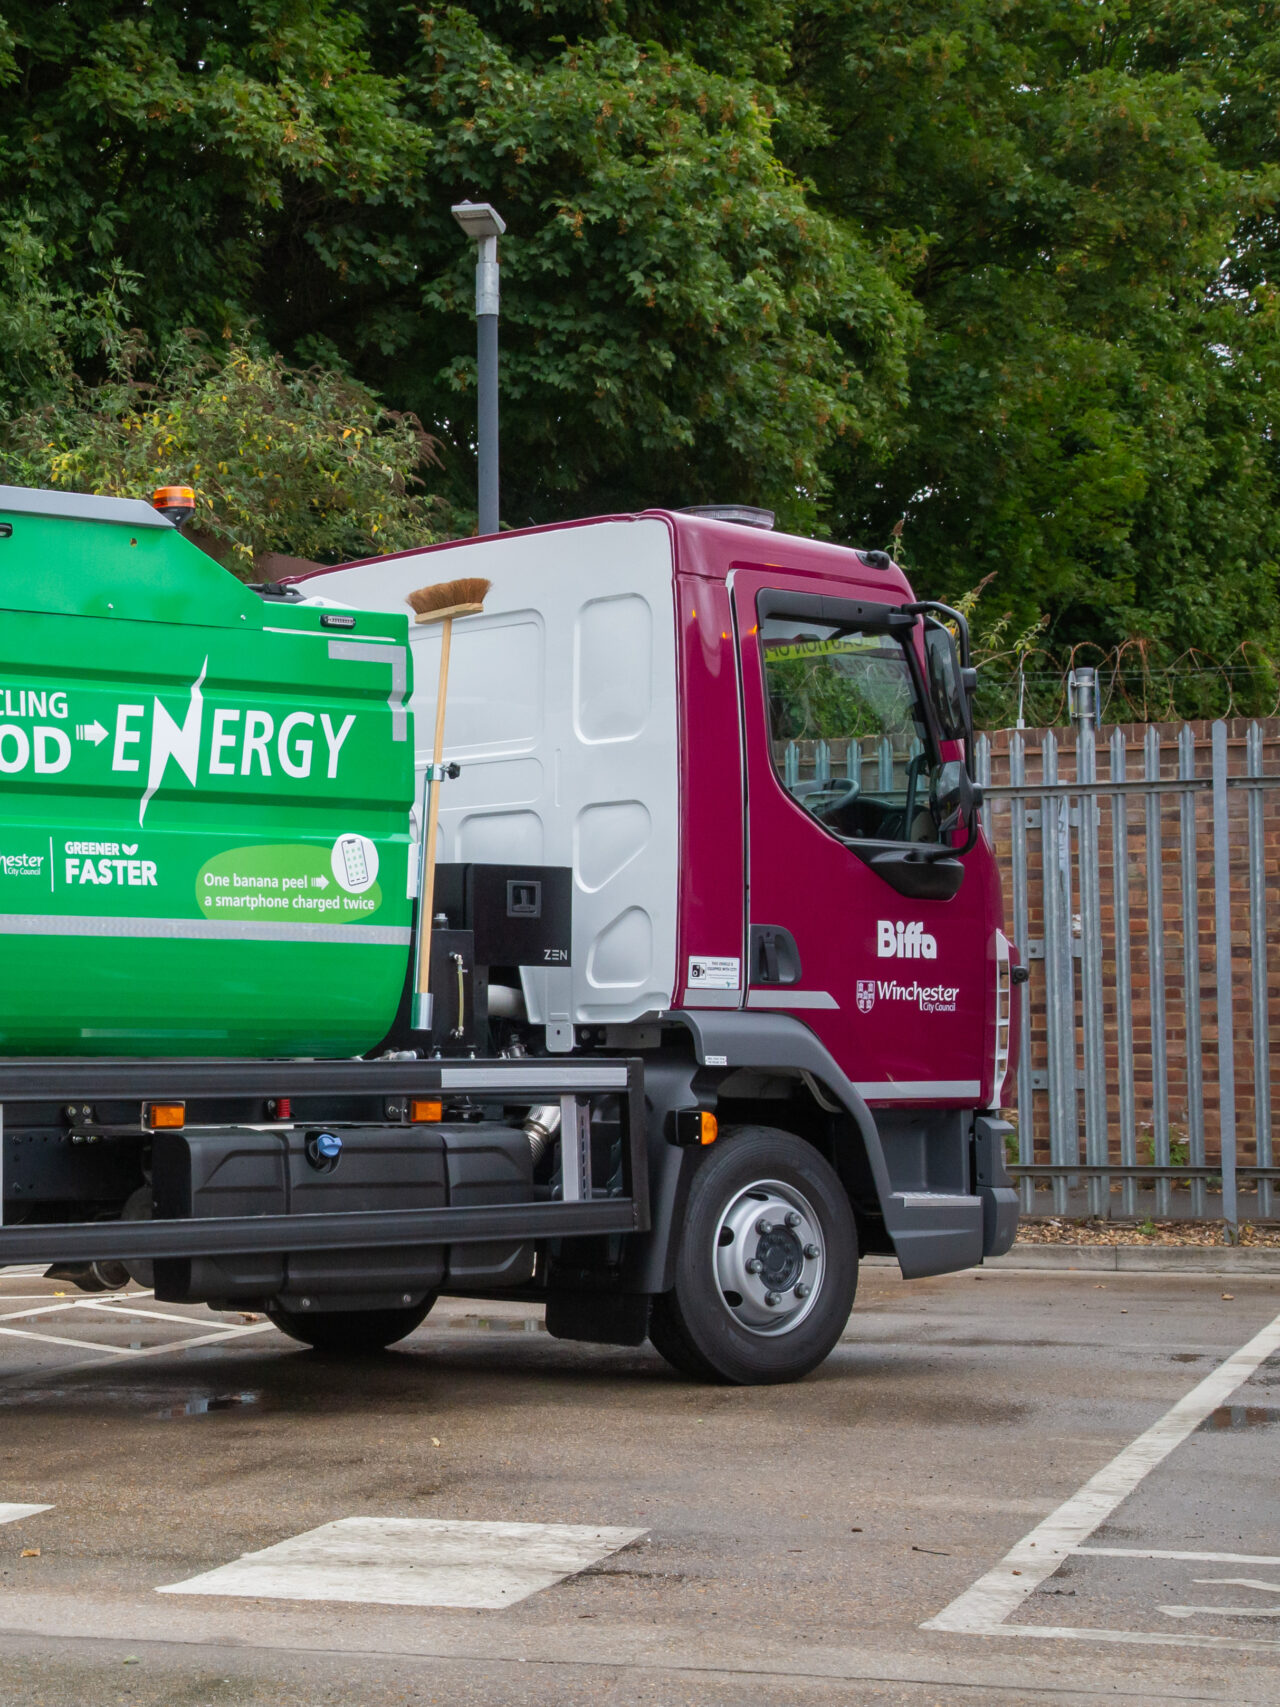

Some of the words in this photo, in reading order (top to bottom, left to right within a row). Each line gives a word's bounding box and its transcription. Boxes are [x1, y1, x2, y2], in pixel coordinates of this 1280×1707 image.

[111, 654, 357, 828] ENERGY
[64, 841, 120, 856] GREENER
[7, 867, 19, 877] City
[19, 867, 41, 876] Council
[65, 858, 158, 886] FASTER
[204, 873, 230, 887] One
[233, 873, 279, 889] banana
[282, 874, 308, 891] peel
[204, 896, 212, 907] a
[215, 894, 289, 911] smartphone
[292, 895, 340, 912] charged
[343, 896, 375, 910] twice
[877, 920, 937, 959] Biffa
[544, 949, 568, 961] ZEN
[877, 980, 960, 1011] Winchester
[923, 1002, 934, 1014] City
[934, 1002, 956, 1012] Council
